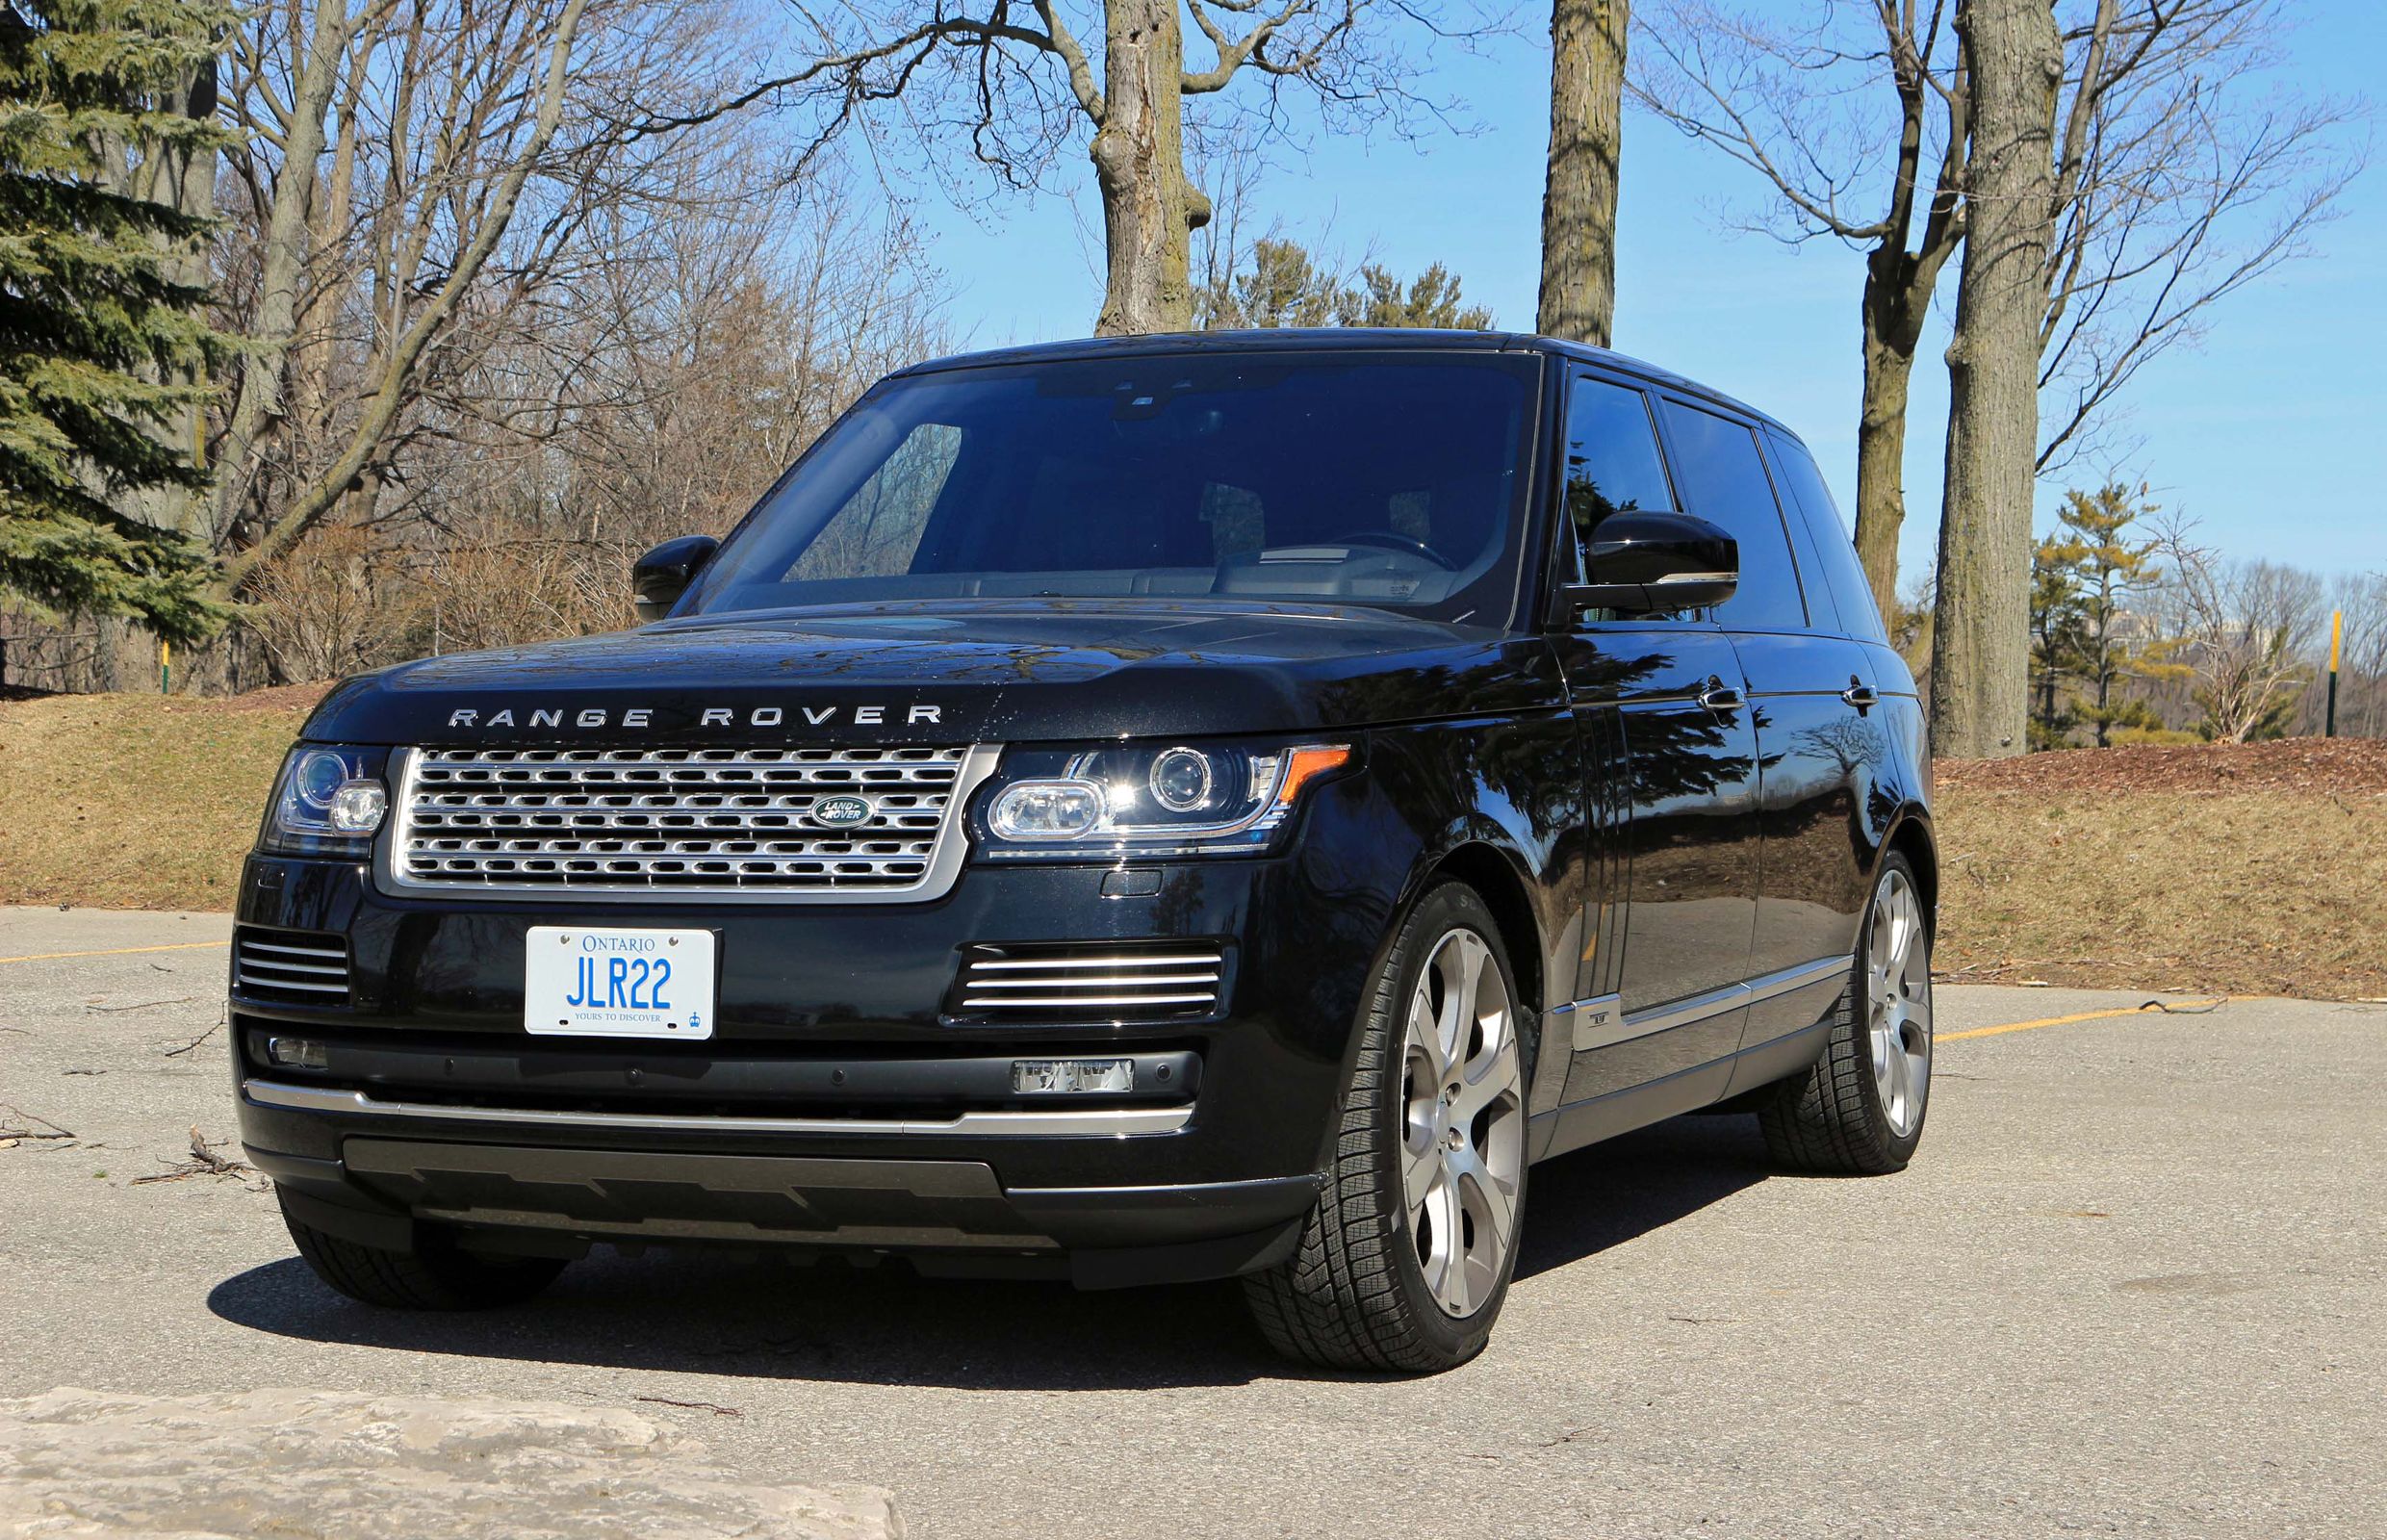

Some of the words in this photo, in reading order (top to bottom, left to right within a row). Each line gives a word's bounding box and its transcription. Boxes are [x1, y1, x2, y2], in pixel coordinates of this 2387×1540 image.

[449, 708, 653, 728] RANGE
[700, 705, 941, 726] ROVER
[824, 802, 854, 810] LAND
[825, 809, 861, 819] ROVER
[582, 935, 655, 953] ONTARIO
[566, 957, 672, 1010] JLR22
[575, 1013, 603, 1021] YOURS
[604, 1013, 617, 1021] TO
[619, 1014, 661, 1022] DISCOVER
